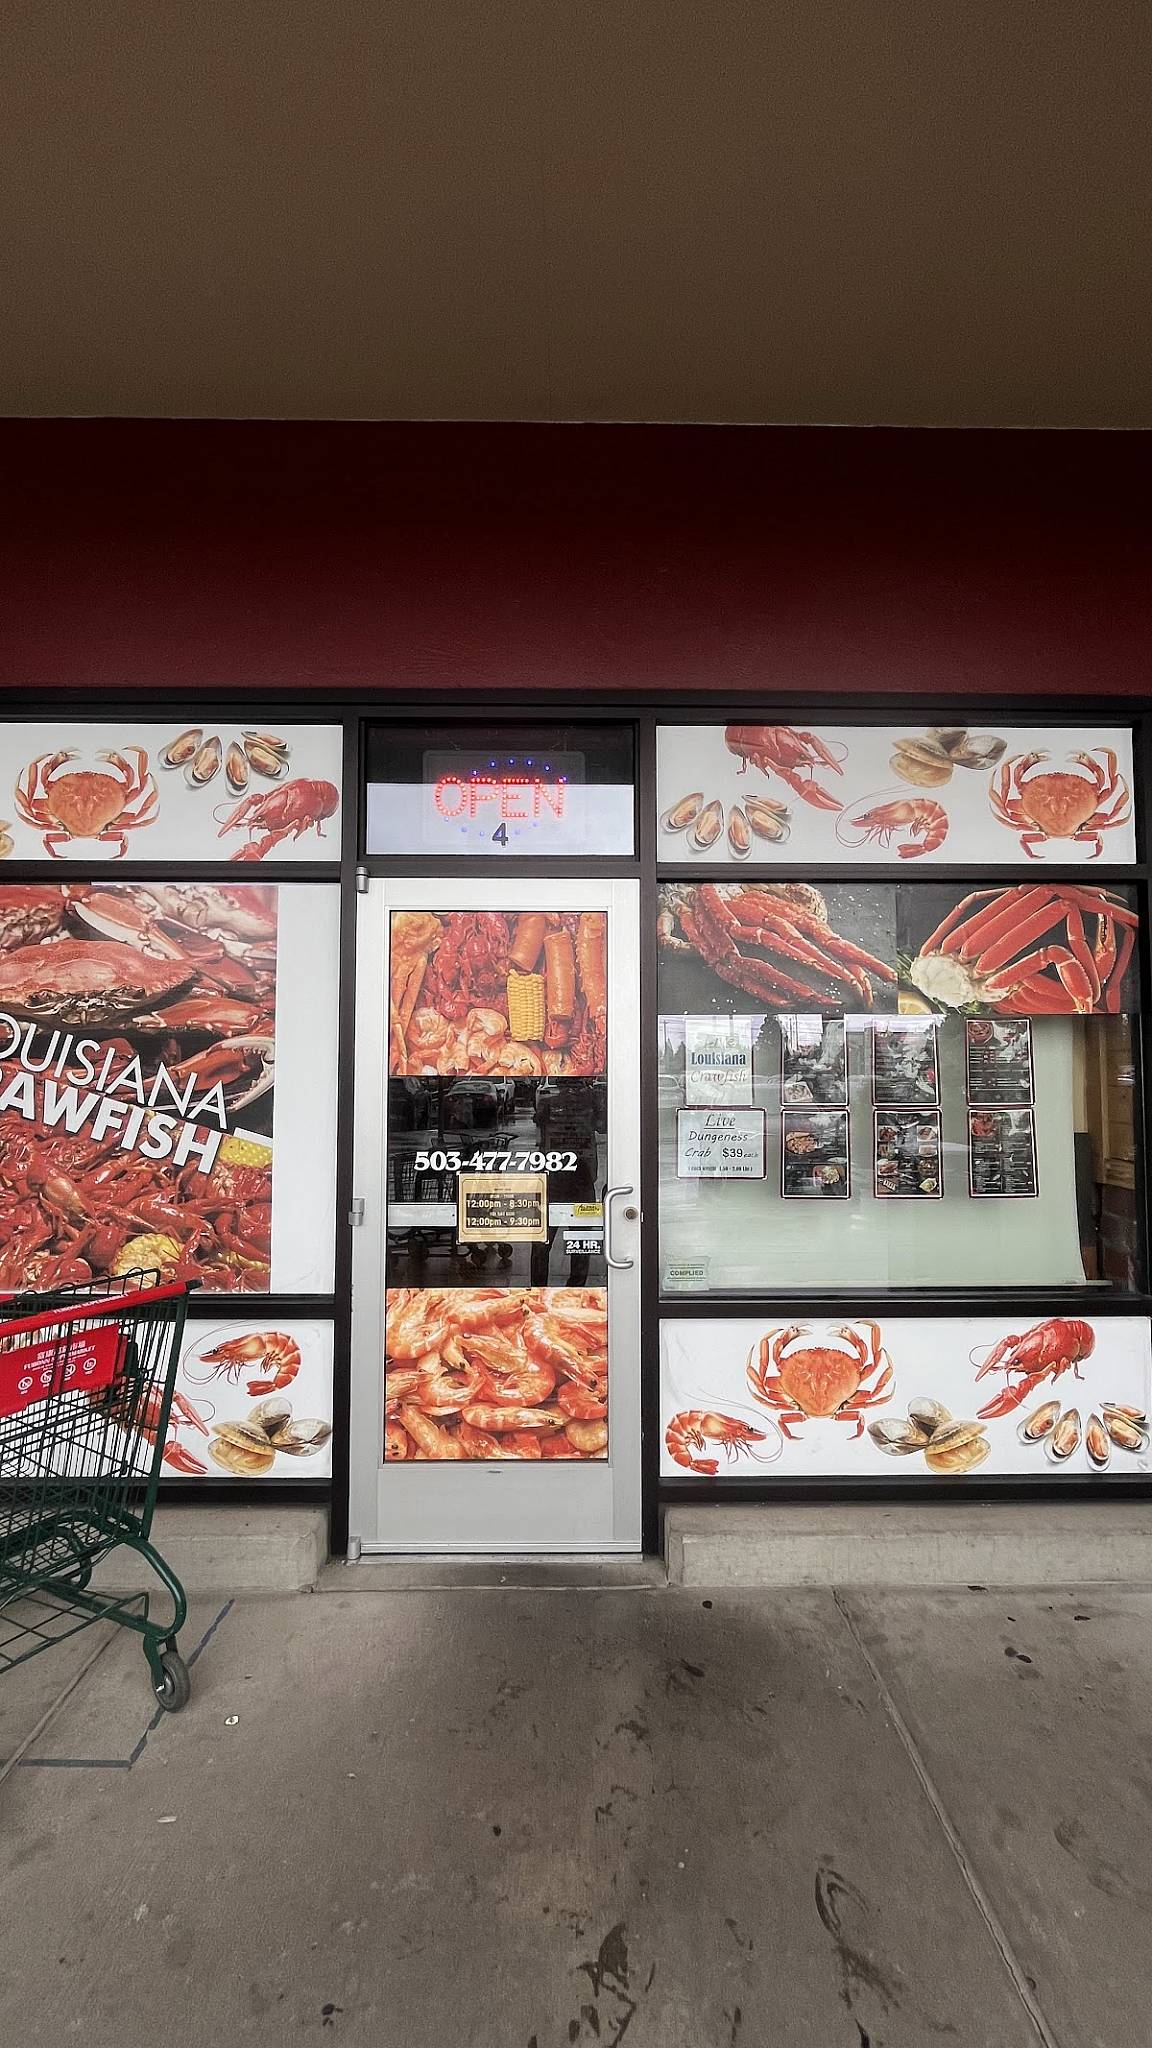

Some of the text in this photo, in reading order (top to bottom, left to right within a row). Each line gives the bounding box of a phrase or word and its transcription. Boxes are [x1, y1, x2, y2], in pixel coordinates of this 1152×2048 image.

[434, 776, 567, 818] OPEN
[492, 822, 508, 847] 4
[691, 1052, 746, 1065] Louisiana
[0, 1071, 222, 1174] AWFISH
[704, 1113, 736, 1127] Live
[688, 1130, 748, 1143] Dungeness
[684, 1147, 712, 1158] Crab
[722, 1147, 743, 1159] $39
[414, 1150, 577, 1172] 503-477-7982
[467, 1199, 501, 1209] 12:00pm
[509, 1199, 540, 1209] 8:30pm
[467, 1217, 502, 1227] 12:00pm
[509, 1217, 540, 1227] 9:30pm
[566, 1240, 601, 1249] 24 HR.
